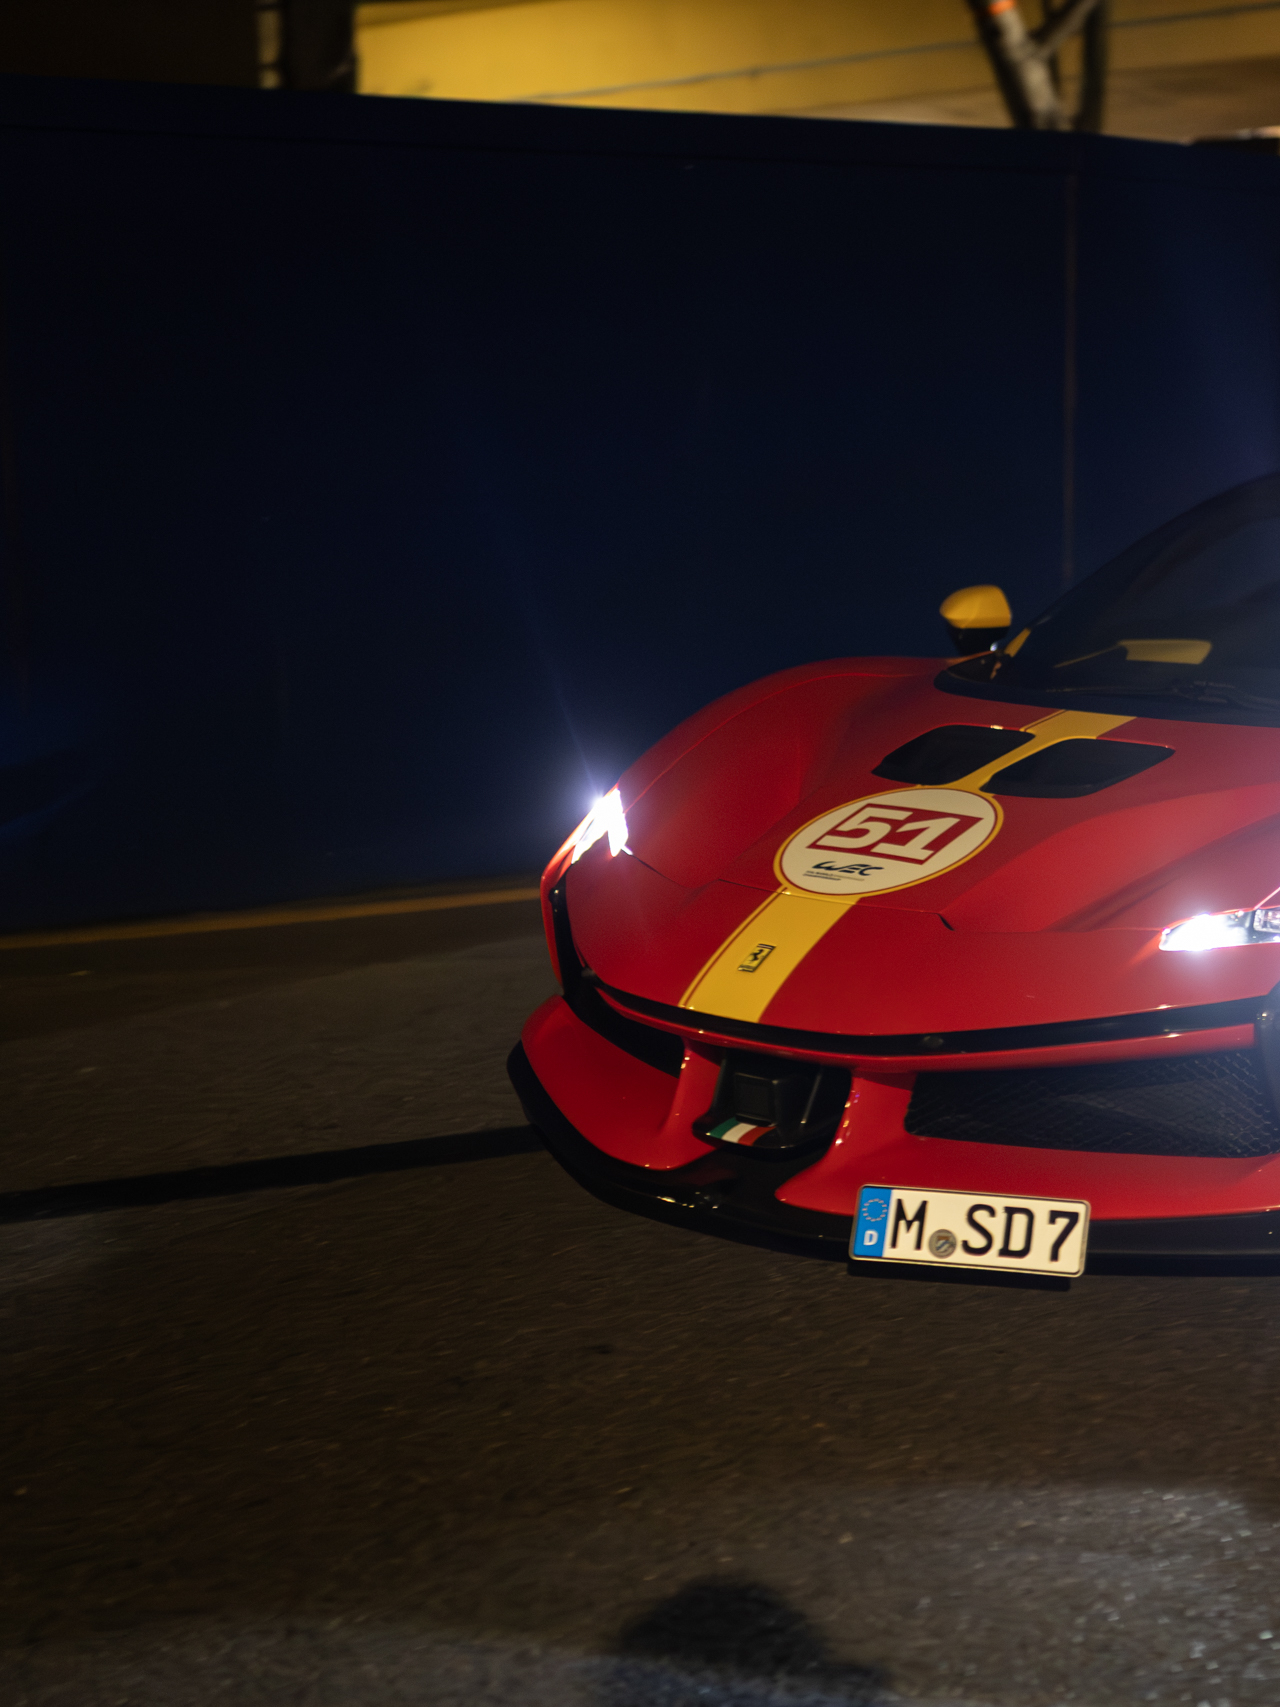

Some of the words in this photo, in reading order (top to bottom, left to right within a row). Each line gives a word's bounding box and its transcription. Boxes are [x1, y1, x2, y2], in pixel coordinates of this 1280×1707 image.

[813, 805, 963, 862] 51
[812, 861, 885, 876] WEC
[862, 1229, 879, 1246] D
[890, 1198, 929, 1252] M
